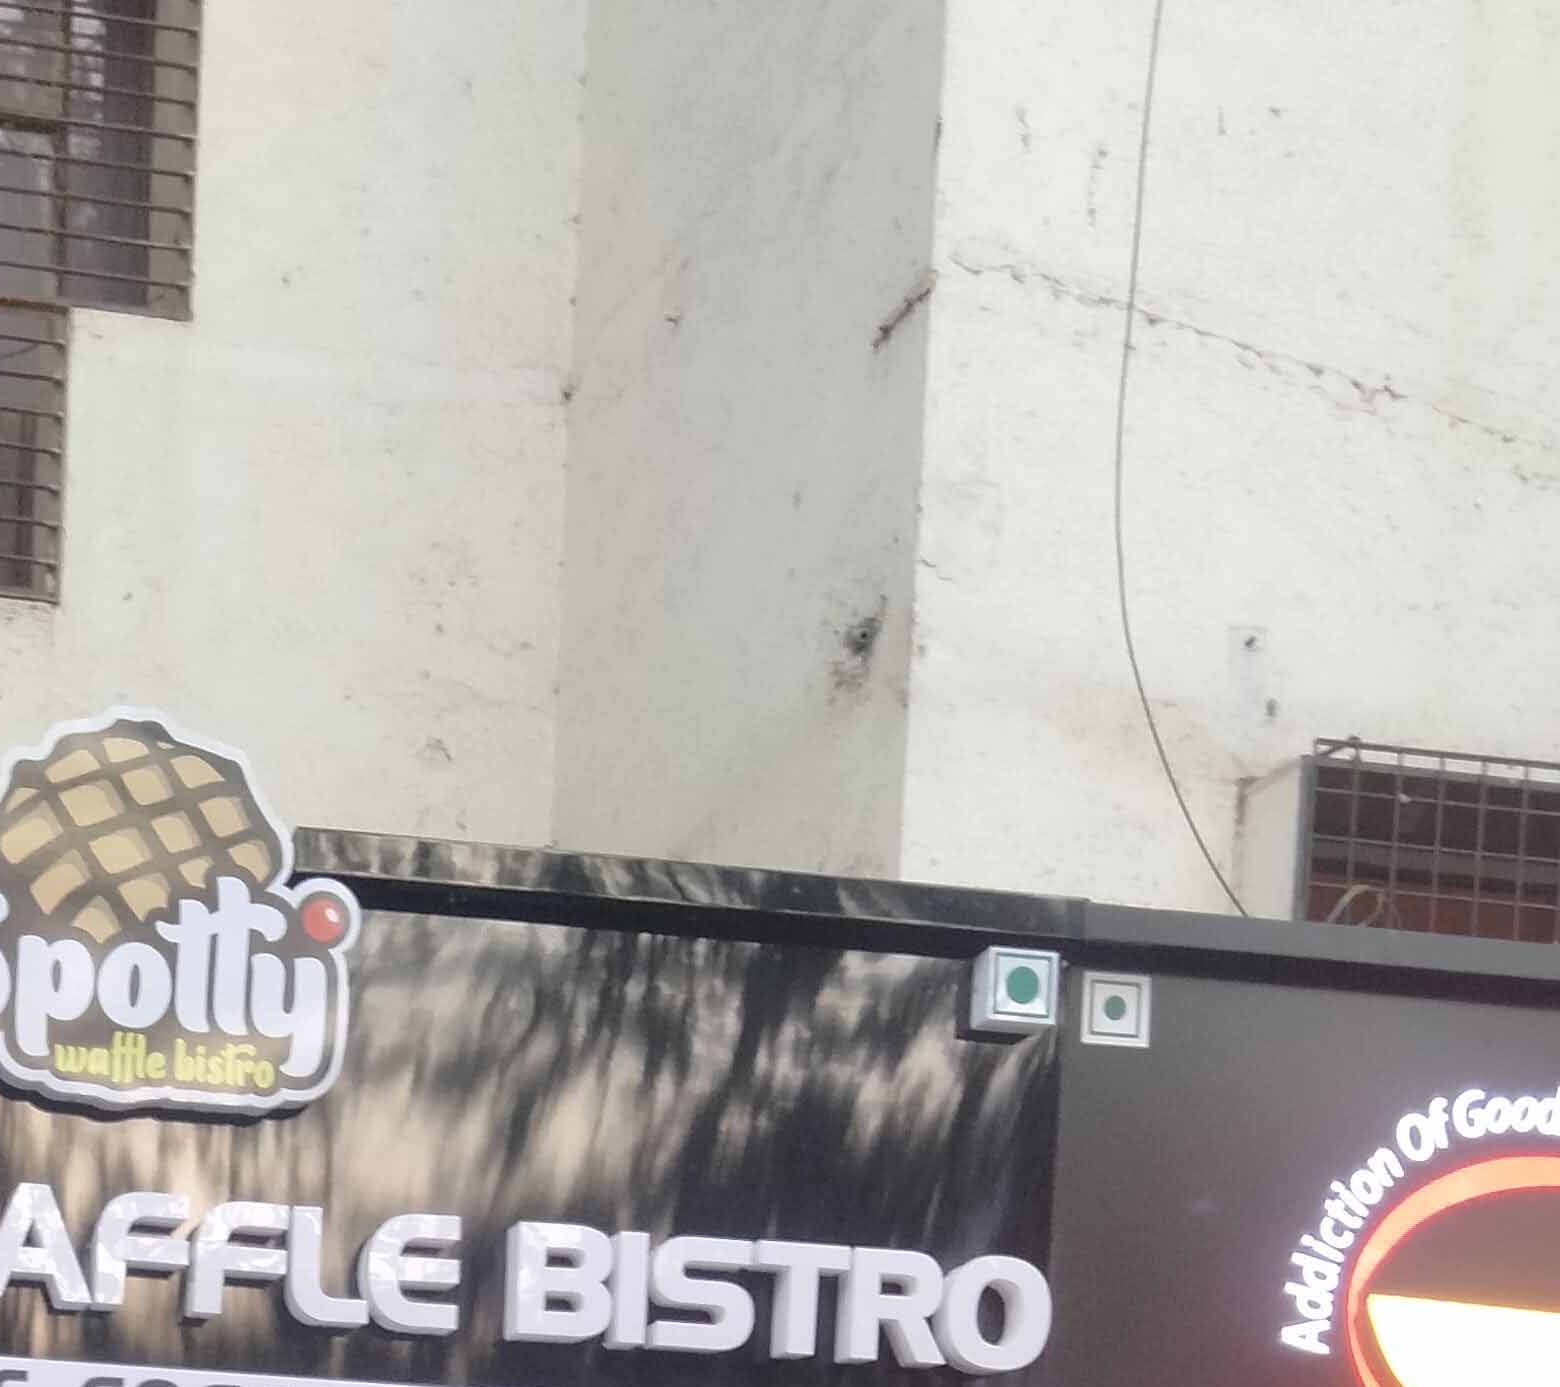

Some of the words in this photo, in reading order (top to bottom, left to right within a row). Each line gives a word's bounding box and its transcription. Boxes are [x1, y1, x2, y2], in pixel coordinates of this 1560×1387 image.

[53, 1030, 167, 1083] waffle
[173, 1037, 276, 1089] bistro
[503, 1220, 1053, 1376] BISTRO
[1280, 1146, 1404, 1356] Addiction
[1395, 1096, 1448, 1162] Of
